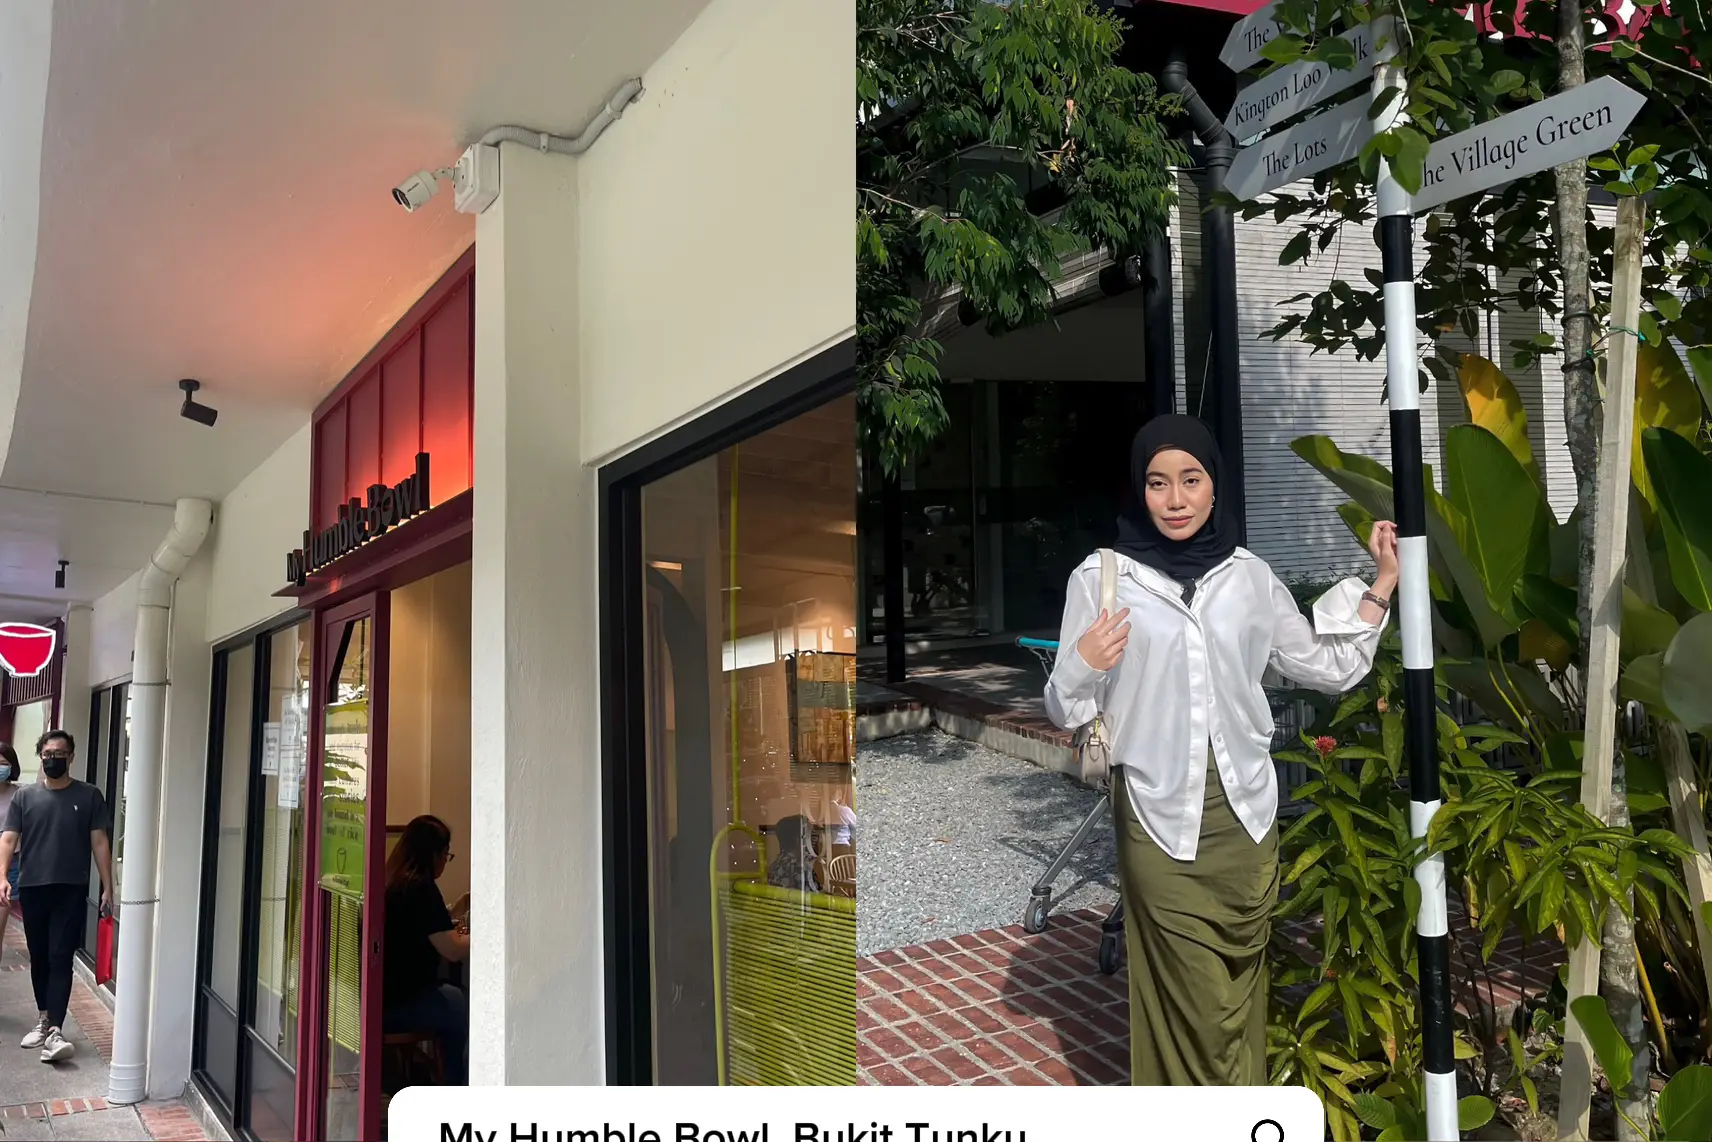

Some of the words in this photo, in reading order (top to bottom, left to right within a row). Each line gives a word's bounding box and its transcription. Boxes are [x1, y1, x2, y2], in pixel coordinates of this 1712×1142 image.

[1244, 26, 1270, 52] The
[1234, 86, 1289, 126] Kington
[1293, 68, 1322, 95] Loo
[1263, 151, 1289, 176] The
[1293, 137, 1328, 165] Lots
[1423, 157, 1445, 187] he
[1450, 135, 1528, 175] Village
[1536, 105, 1613, 146] Green
[303, 497, 370, 573] Humble
[367, 452, 430, 537] Bowl
